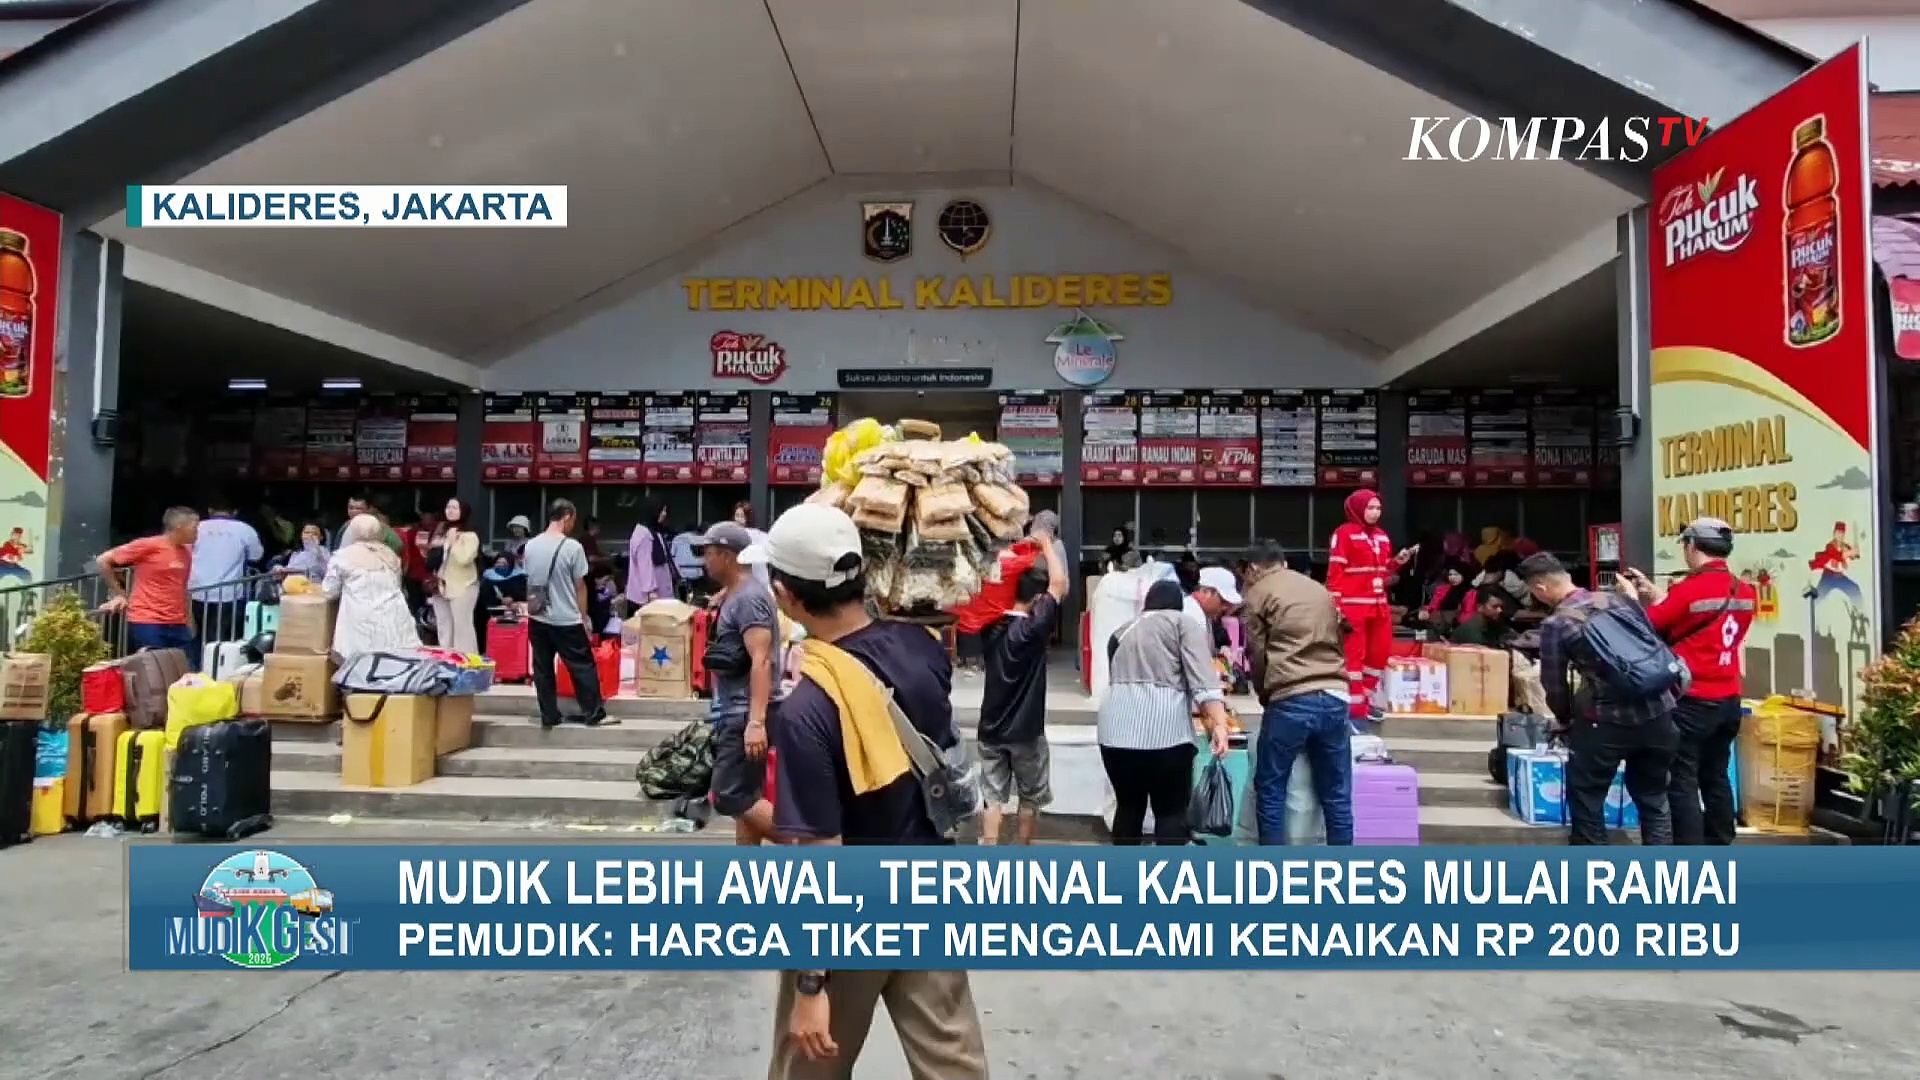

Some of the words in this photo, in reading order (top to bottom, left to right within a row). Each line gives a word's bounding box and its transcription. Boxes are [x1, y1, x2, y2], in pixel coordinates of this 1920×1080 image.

[1680, 215, 1752, 260] HARUM
[682, 275, 904, 311] TERMINAL
[915, 271, 1174, 309] KALIDERES
[1076, 342, 1094, 356] Le
[727, 364, 776, 380] HARUM
[877, 373, 911, 383] Jakarta
[912, 373, 937, 383] untuk
[939, 373, 985, 383] Indonesia
[737, 396, 750, 407] 25
[820, 396, 832, 407] 26
[1659, 414, 1793, 479] TERMINAL
[1407, 447, 1446, 465] GARUDA
[1448, 447, 1467, 465] MAS
[1658, 481, 1798, 537] KALIDERES
